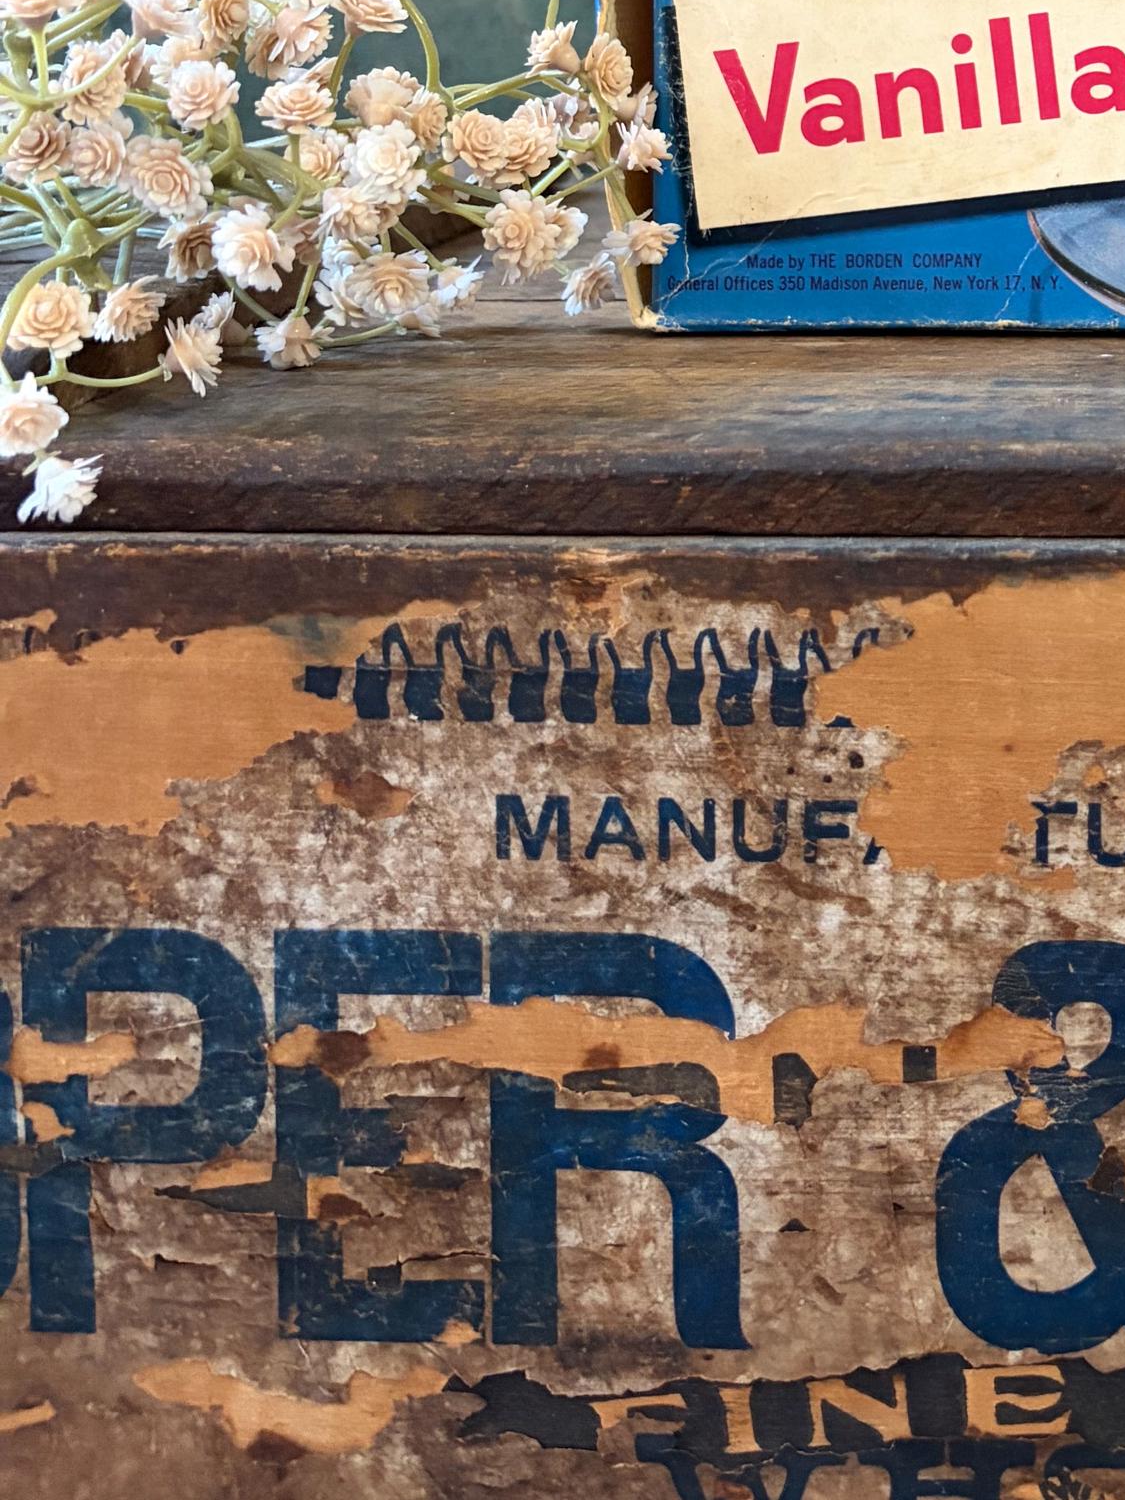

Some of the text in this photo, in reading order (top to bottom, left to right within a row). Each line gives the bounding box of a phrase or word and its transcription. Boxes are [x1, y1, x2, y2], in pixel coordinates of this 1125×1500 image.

[747, 253, 983, 271] Made by THE BORDEN COMPANY
[723, 275, 774, 291] Offices
[778, 276, 805, 291] 350
[810, 276, 868, 291] Madison
[872, 275, 928, 293] Avenue,
[932, 276, 962, 291] New
[966, 275, 999, 291] York
[0, 927, 753, 1350] PER
